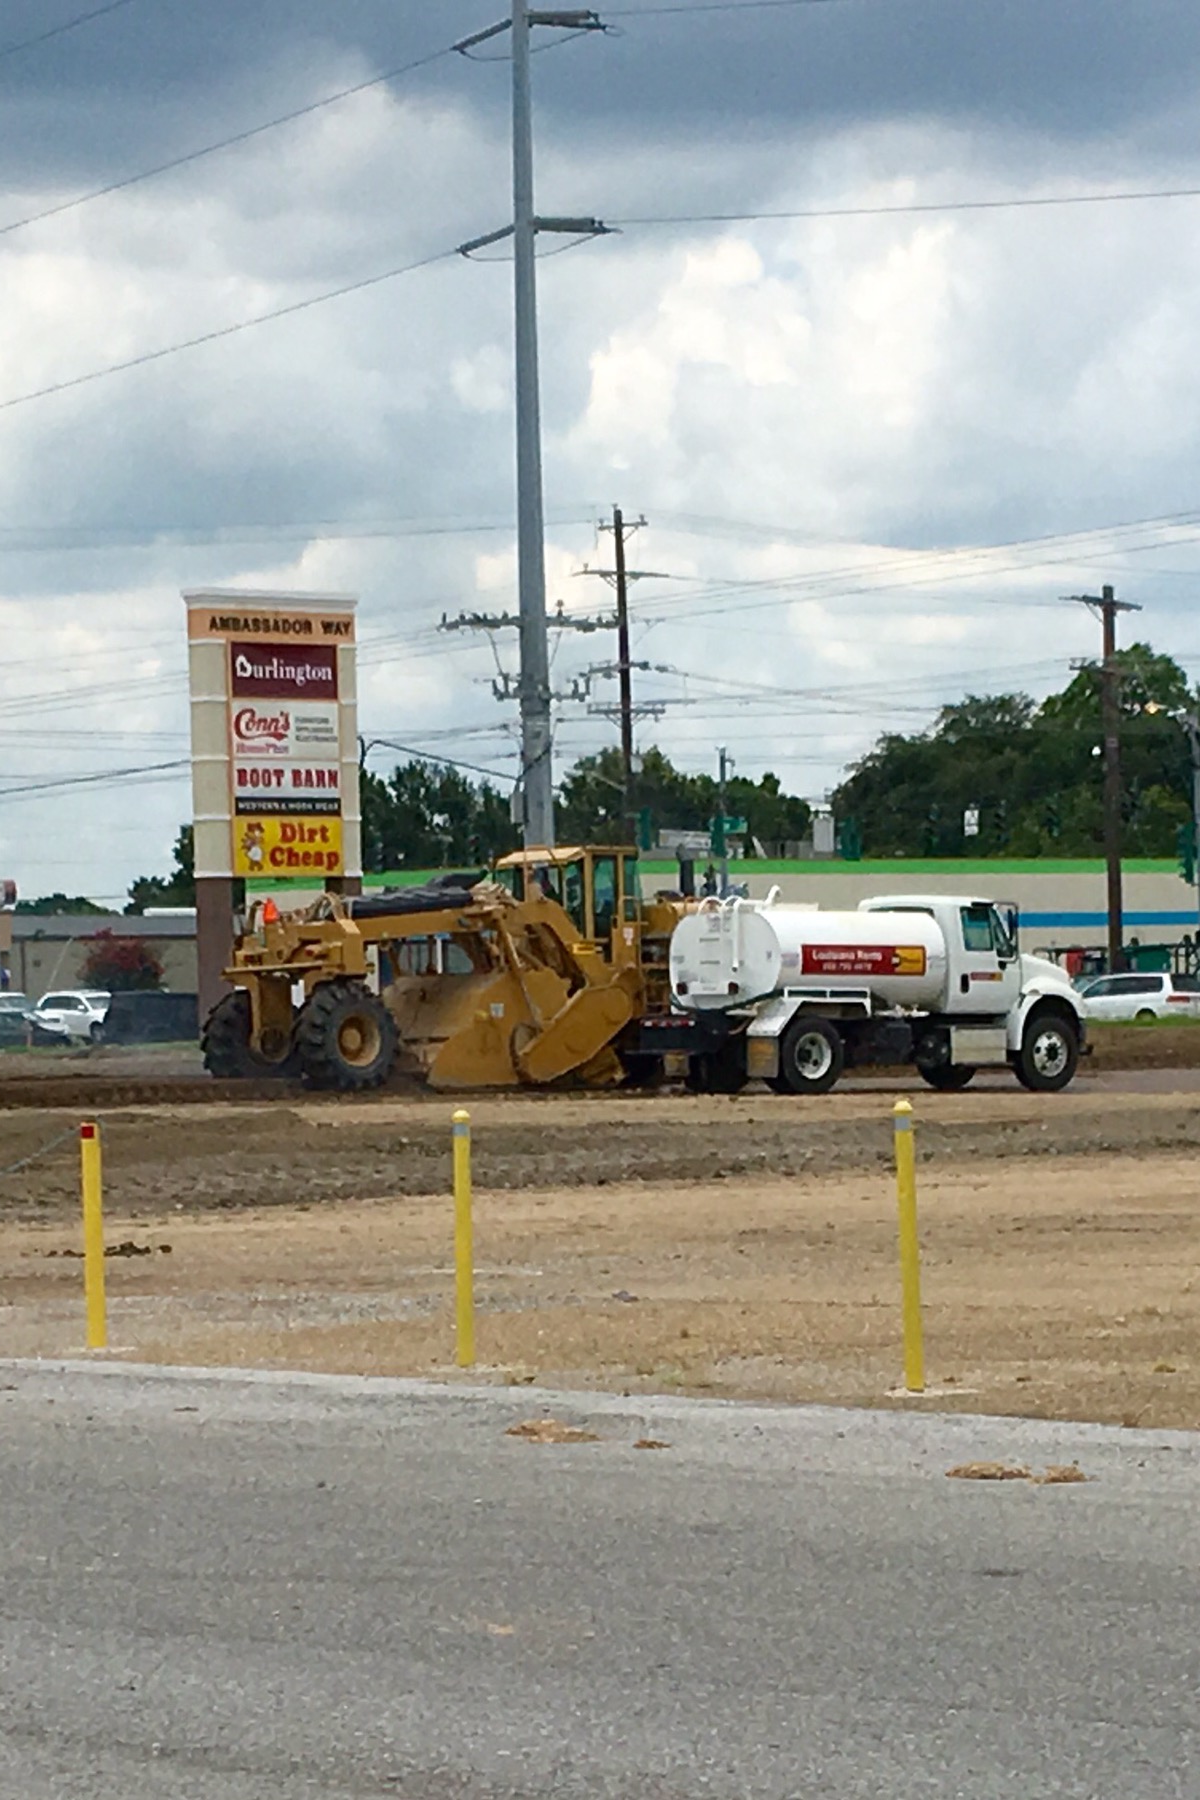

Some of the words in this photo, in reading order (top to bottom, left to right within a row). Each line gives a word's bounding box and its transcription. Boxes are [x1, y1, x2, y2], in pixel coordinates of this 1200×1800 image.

[209, 617, 312, 635] AMBASSADOR
[320, 621, 351, 636] WAY
[235, 654, 333, 687] Burlington
[234, 707, 291, 741] Conn's
[237, 768, 285, 788] BOOT
[291, 769, 339, 789] BARN
[280, 822, 330, 844] Dirt
[269, 845, 340, 872] Cheap
